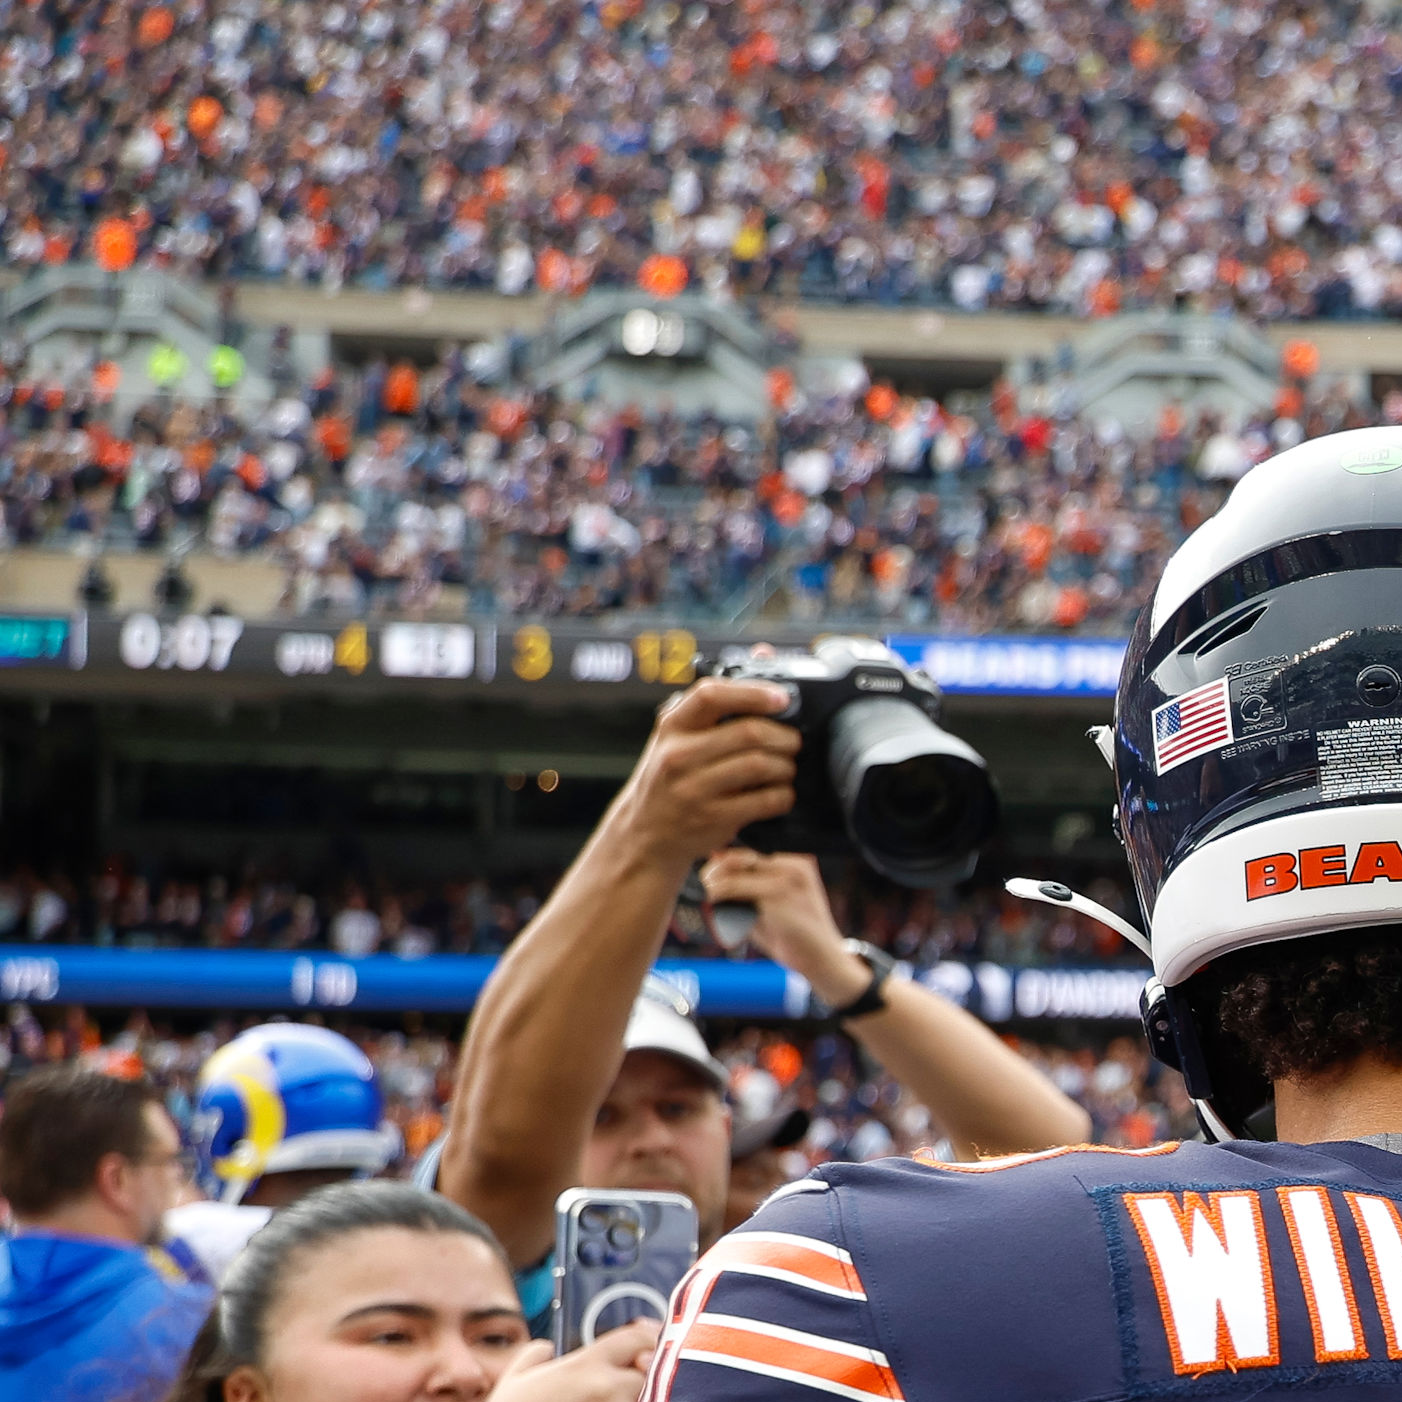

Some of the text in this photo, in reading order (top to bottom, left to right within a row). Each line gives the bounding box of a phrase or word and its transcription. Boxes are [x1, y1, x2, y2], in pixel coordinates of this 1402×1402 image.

[120, 613, 244, 671] 0:07
[334, 621, 372, 675] 4
[512, 624, 553, 682] 3
[631, 629, 697, 685] 12
[1220, 747, 1237, 760] SEE
